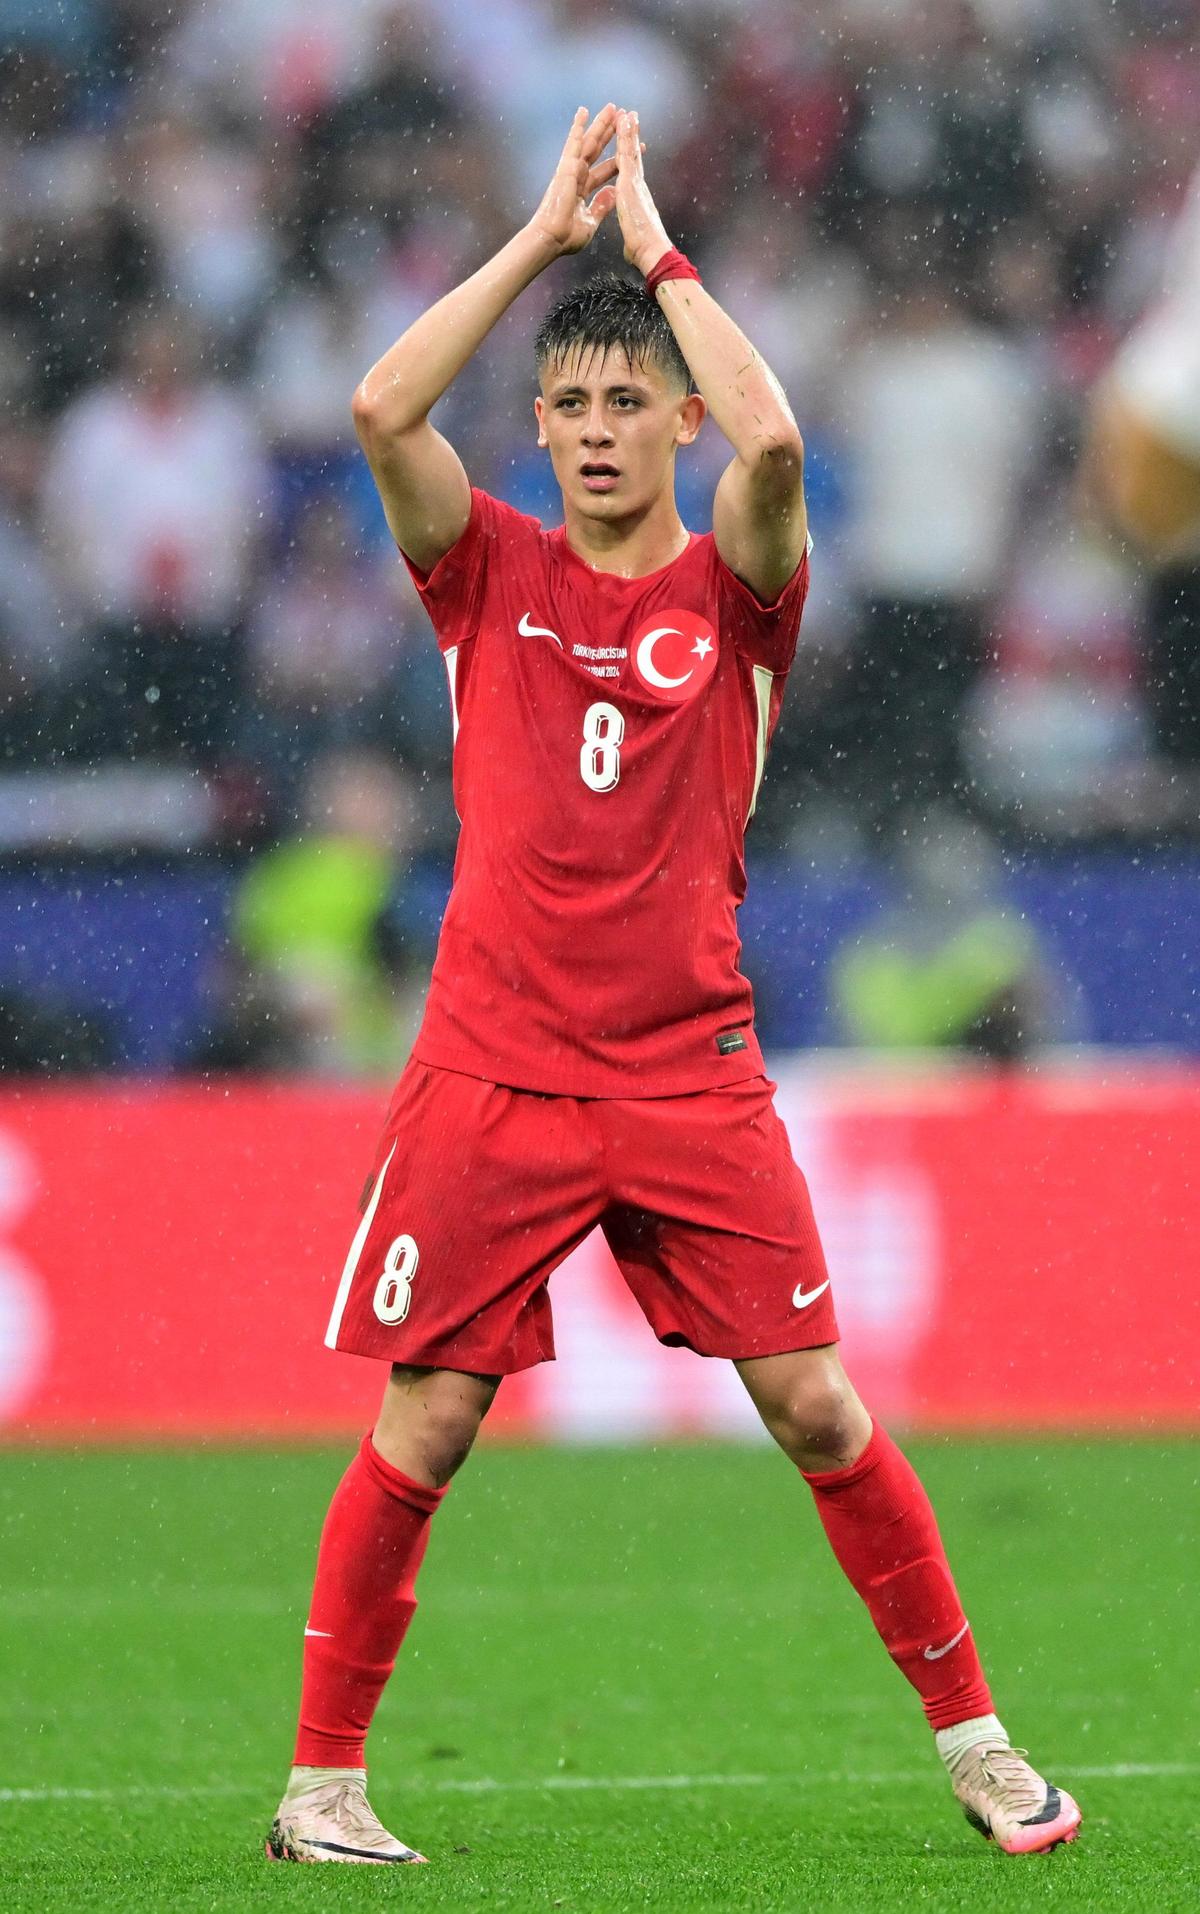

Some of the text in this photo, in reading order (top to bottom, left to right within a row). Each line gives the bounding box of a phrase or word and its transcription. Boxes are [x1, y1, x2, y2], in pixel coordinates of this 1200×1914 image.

[606, 666, 619, 677] 2024
[580, 702, 625, 793] 8
[373, 1234, 419, 1326] 8
